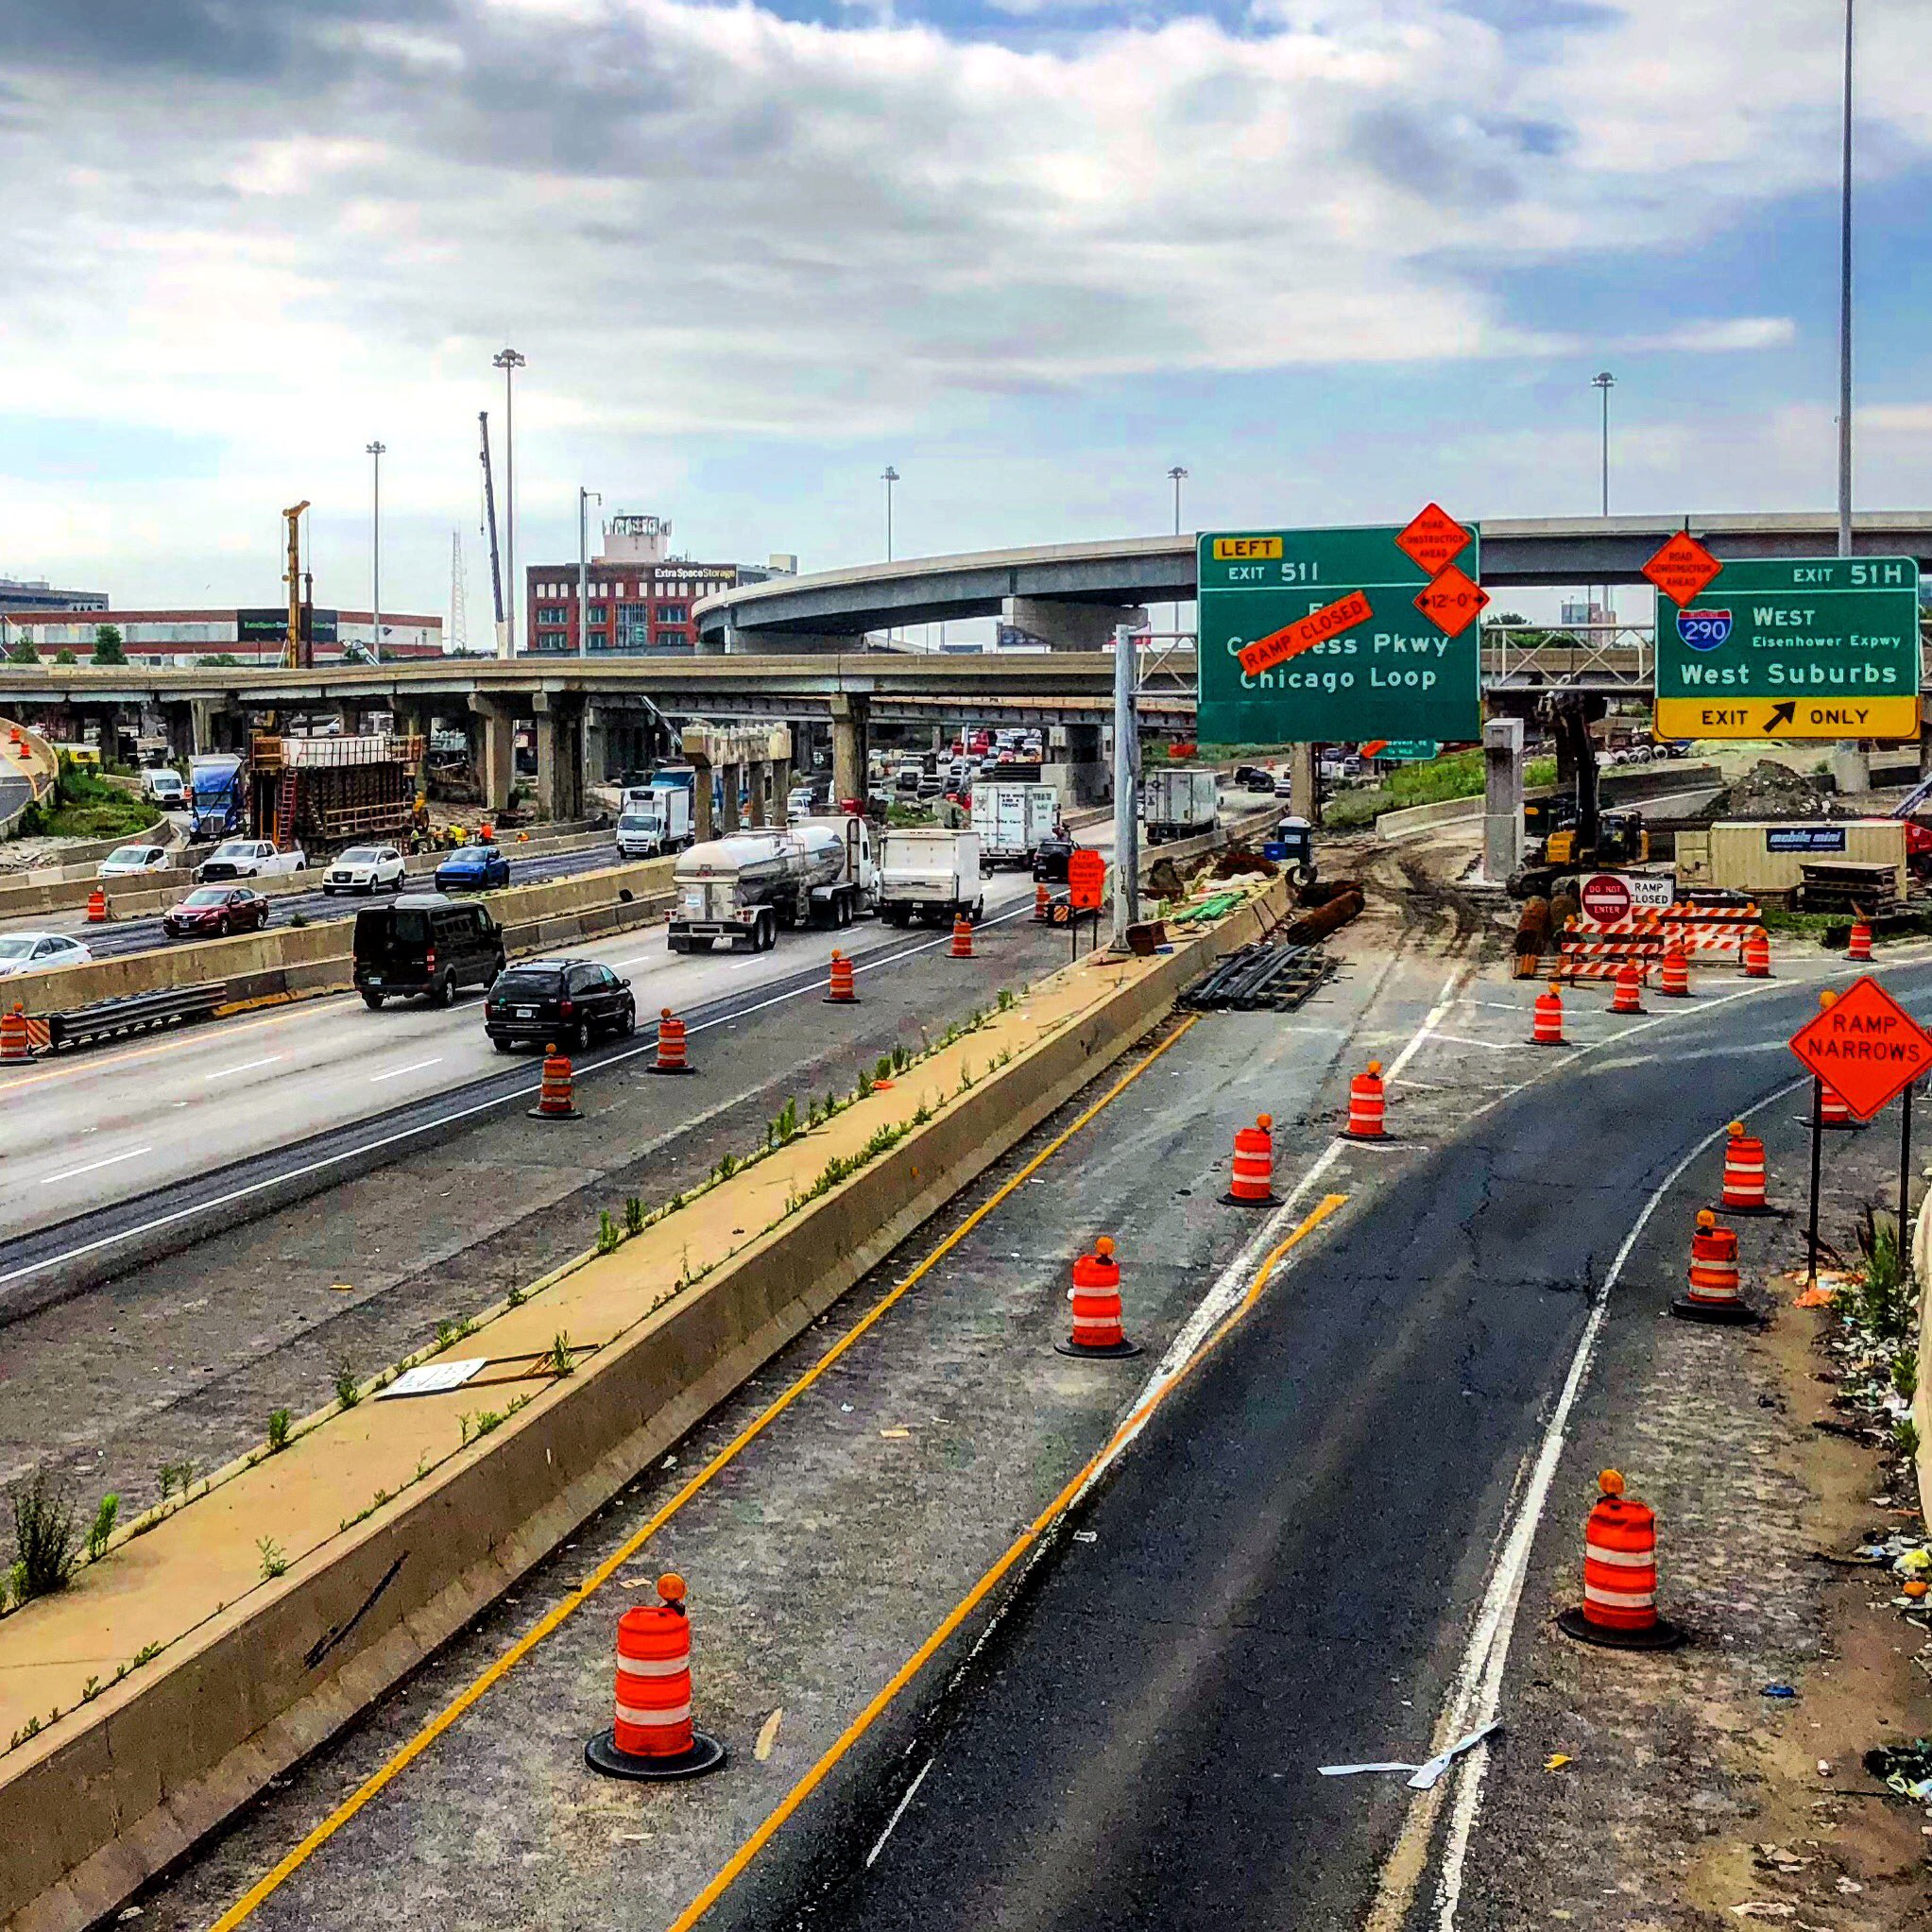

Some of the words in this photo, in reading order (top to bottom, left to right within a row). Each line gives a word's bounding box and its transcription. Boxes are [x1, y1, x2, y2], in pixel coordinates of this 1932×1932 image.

[1421, 521, 1444, 529] ROAD
[1221, 540, 1273, 556] LEFT
[1420, 549, 1447, 557] AHEAD
[1668, 552, 1692, 561] ROAD
[655, 569, 676, 578] Extra
[677, 568, 703, 579] Space
[703, 568, 735, 579] Storage
[1228, 567, 1265, 580] EXIT
[1666, 577, 1696, 586] AHEAD
[1793, 569, 1833, 582] EXIT
[1850, 565, 1902, 584] 51H
[1753, 607, 1816, 626] WEST
[1246, 634, 1291, 668] RAMP
[1300, 599, 1363, 641] CLOSED
[1684, 621, 1726, 640] 290
[1374, 633, 1449, 657] Pkwy
[1752, 636, 1842, 648] Eisenhower
[1850, 635, 1901, 649] Expwy
[1240, 669, 1355, 693] Chicago
[1371, 667, 1436, 691] Loop
[1681, 664, 1750, 684] West
[1768, 663, 1897, 684] Suburbs
[1701, 710, 1749, 726] EXIT
[1810, 710, 1869, 725] ONLY
[1589, 885, 1601, 894] DO
[1606, 885, 1621, 894] NOT
[1634, 882, 1664, 893] RAMP
[1833, 1013, 1898, 1035] RAMP
[1808, 1038, 1921, 1063] NARROWS
